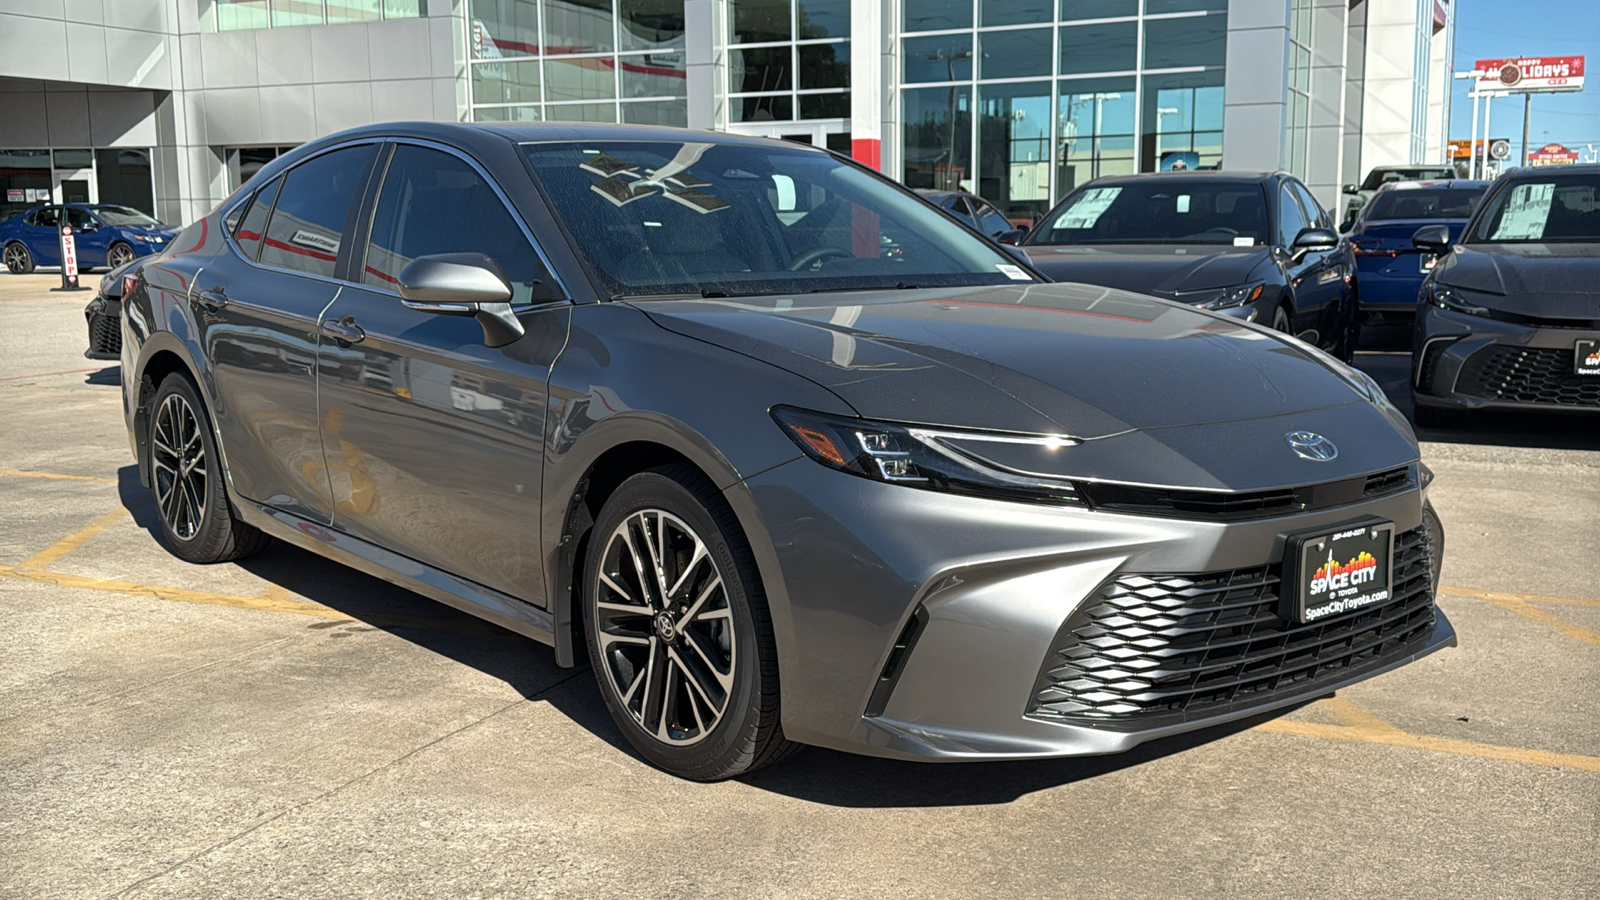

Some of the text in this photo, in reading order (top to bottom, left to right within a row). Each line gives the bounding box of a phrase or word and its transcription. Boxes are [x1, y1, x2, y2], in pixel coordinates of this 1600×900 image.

[65, 238, 75, 274] STOP
[1310, 566, 1377, 595] SPACE CITY
[1338, 587, 1358, 597] TOYOTA
[1306, 591, 1388, 620] SpaceCityToyota.com
